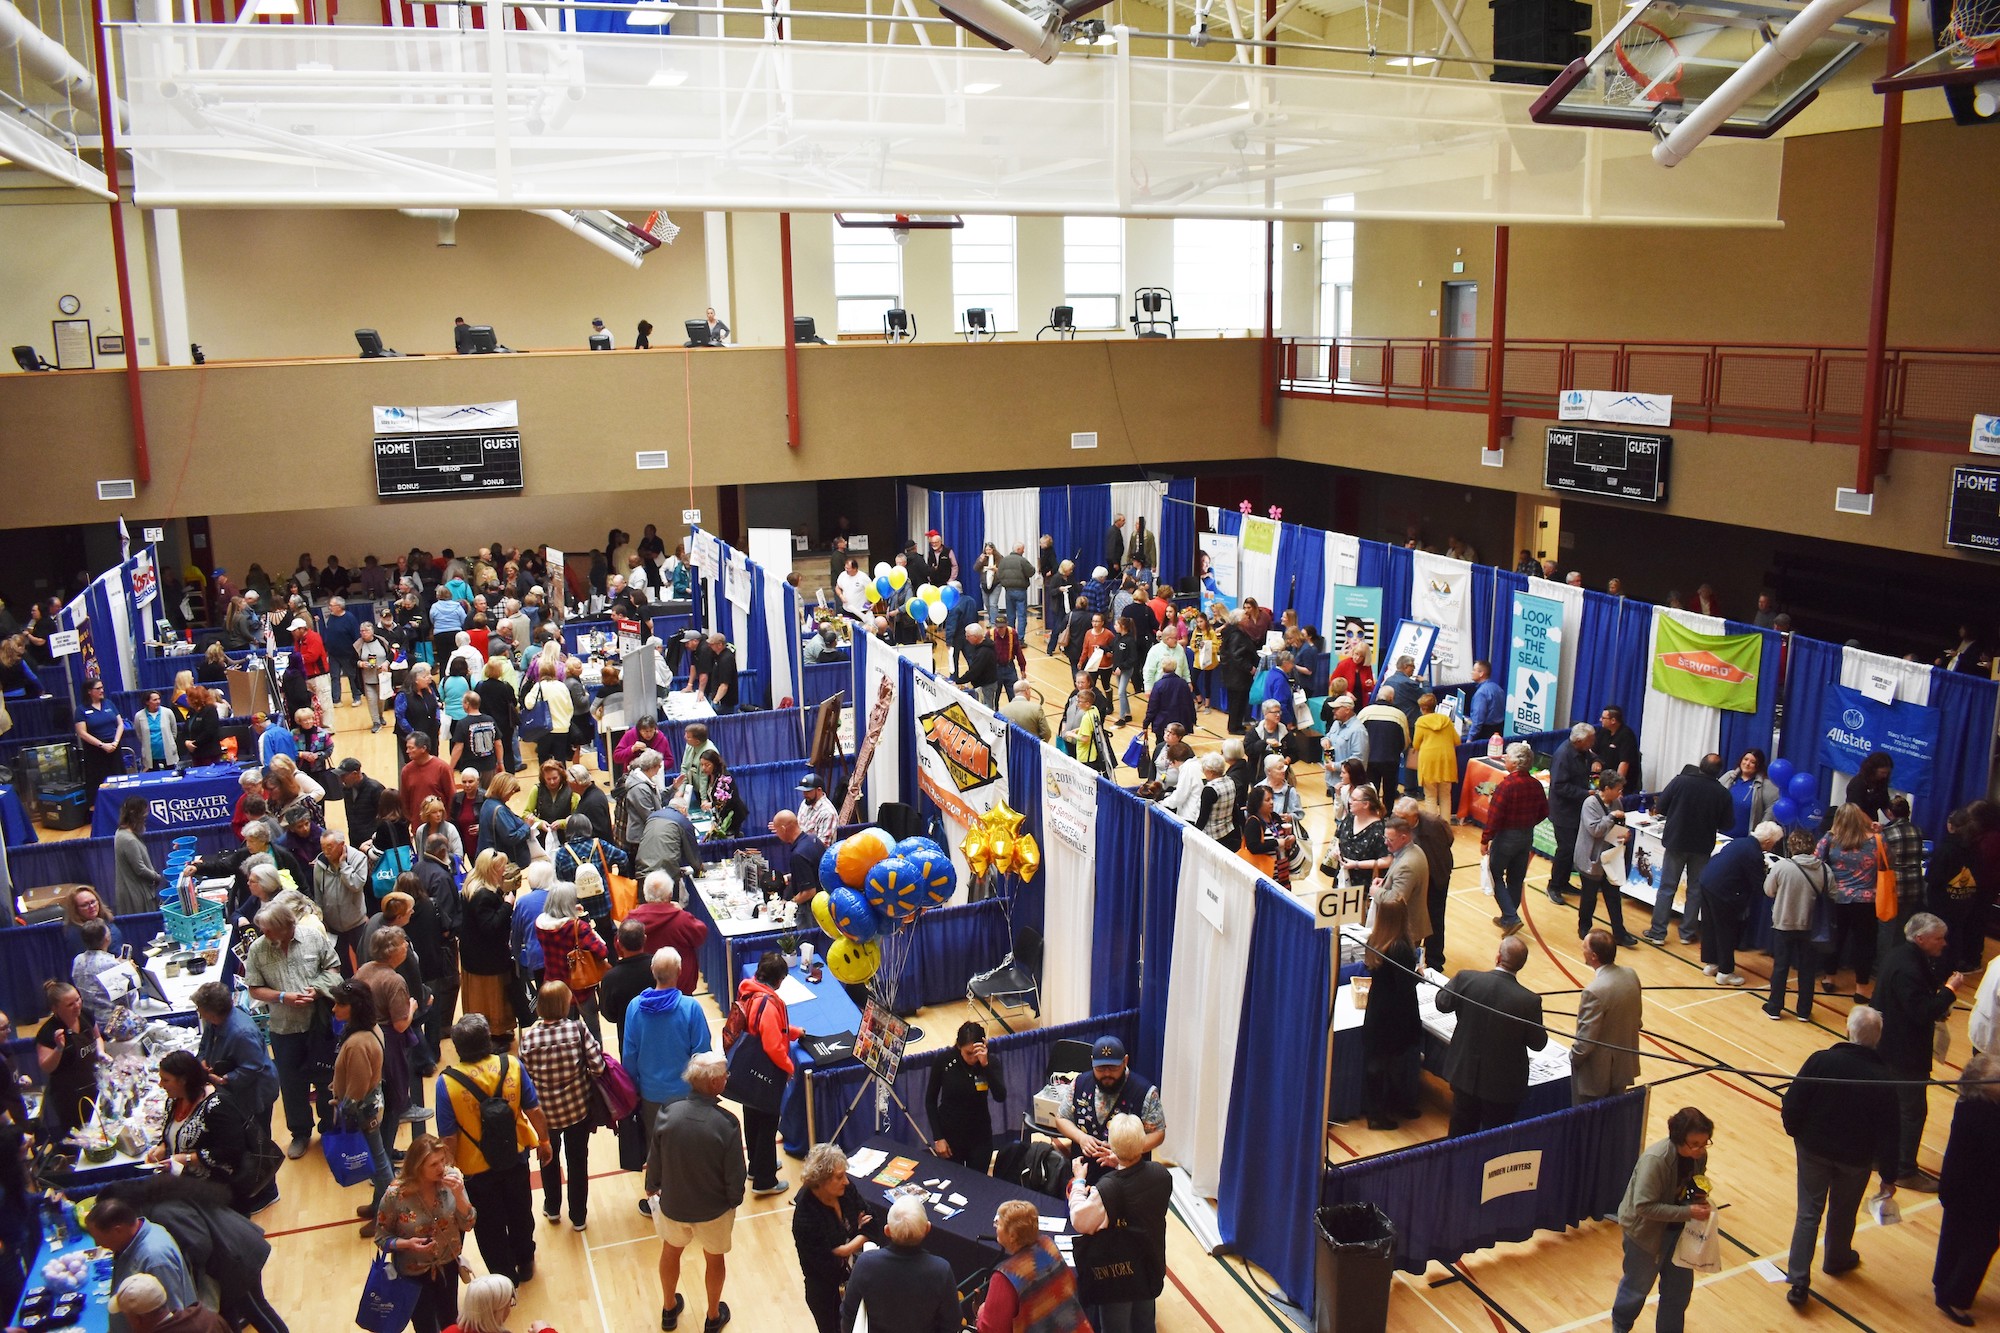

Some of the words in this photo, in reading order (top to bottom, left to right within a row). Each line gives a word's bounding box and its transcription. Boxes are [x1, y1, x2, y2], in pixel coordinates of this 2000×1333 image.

[483, 438, 519, 450] GUEST
[1550, 432, 1573, 446] HOME
[377, 443, 410, 455] HOME
[1629, 441, 1658, 455] GUEST
[439, 465, 461, 473] PERIOD
[397, 482, 420, 490] BONUS
[482, 478, 505, 486] BONUS
[1559, 477, 1576, 486] BONUS
[1957, 473, 1998, 493] HOME
[1623, 486, 1641, 496] BONUS
[684, 511, 700, 520] GH
[1970, 534, 1999, 546] BONUS
[1522, 608, 1553, 626] LOOK
[1525, 624, 1547, 640] FOR
[1403, 646, 1419, 656] BBB
[1525, 638, 1545, 654] THE
[1518, 652, 1549, 670] SEAL.
[1678, 656, 1729, 677] SERVPRO
[1517, 707, 1540, 725] BBB
[1826, 727, 1872, 751] Allstate
[1055, 772, 1072, 785] 2018
[1071, 776, 1094, 796] WINNER
[168, 794, 229, 811] GREATER
[170, 806, 231, 823] NEVADA
[1056, 806, 1074, 822] Senior
[1073, 816, 1087, 834] Living
[1057, 820, 1080, 841] CHATEAU
[1318, 889, 1360, 918] GH
[1488, 1167, 1506, 1179] MINDEN
[1506, 1162, 1532, 1173] LAWYERS
[1091, 1265, 1109, 1281] NEW
[1109, 1261, 1134, 1278] YORK
